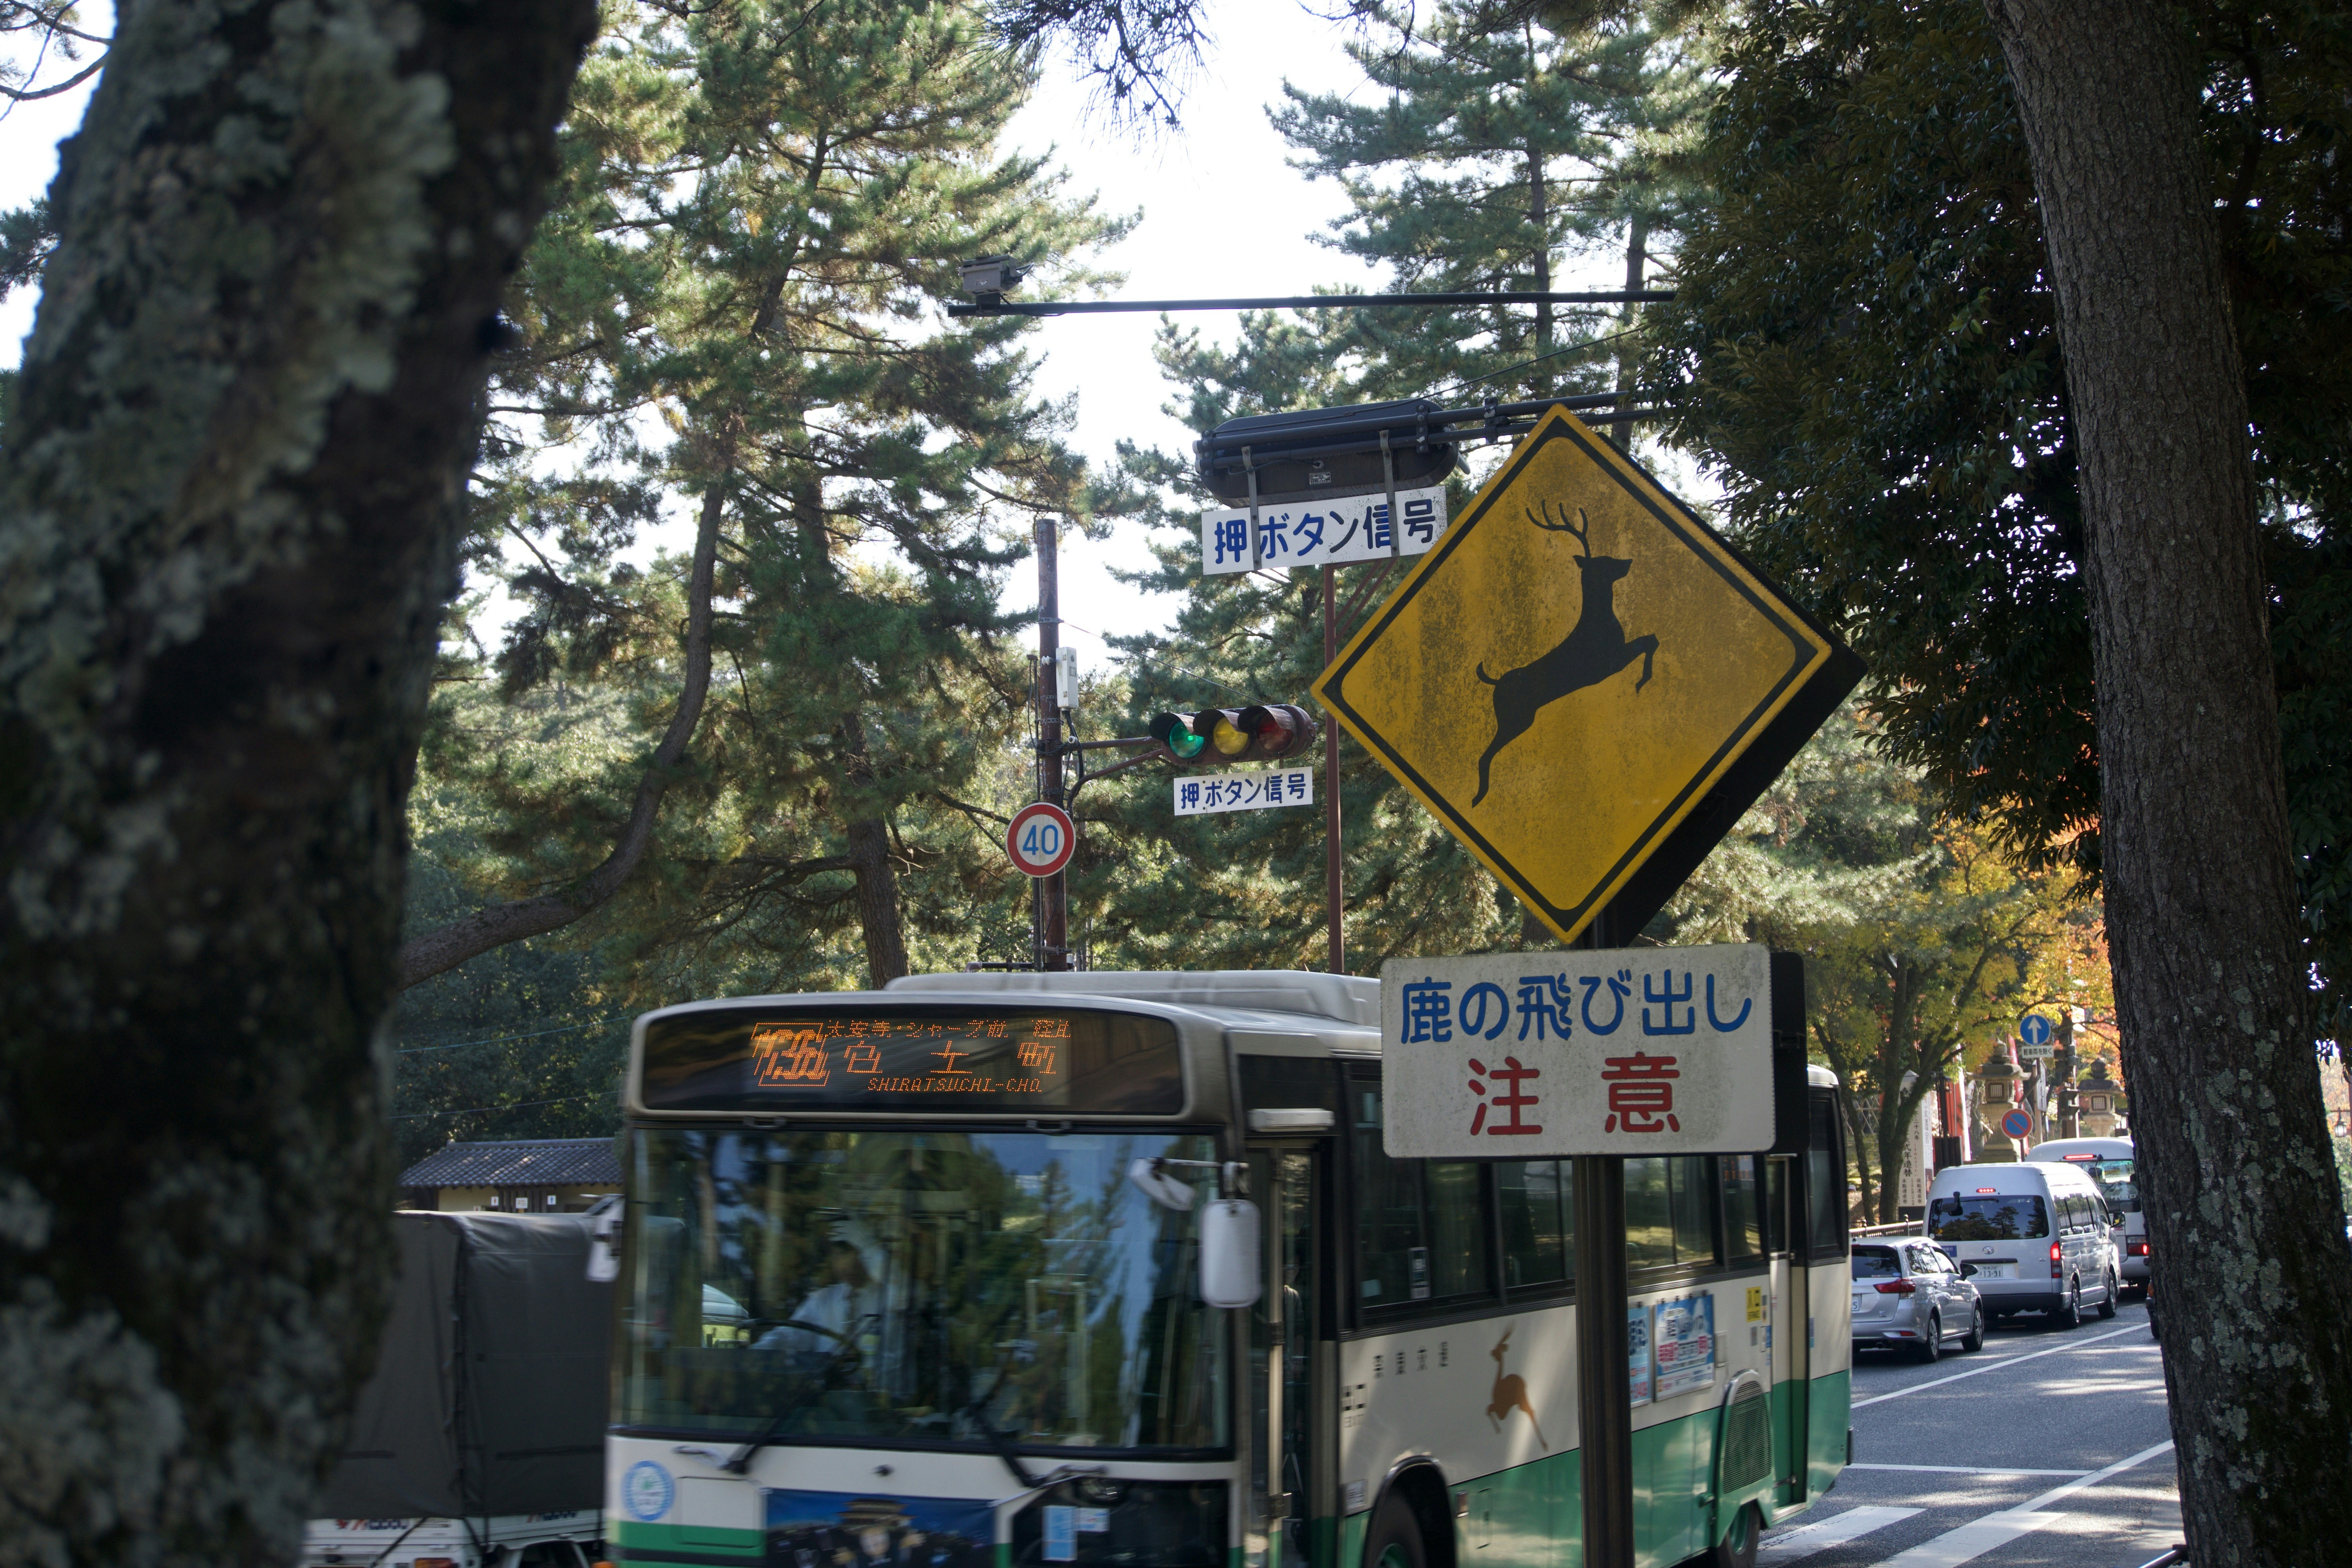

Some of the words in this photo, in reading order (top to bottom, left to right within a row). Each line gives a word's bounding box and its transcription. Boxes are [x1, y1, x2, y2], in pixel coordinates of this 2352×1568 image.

[1215, 499, 1436, 564] 押ボタン信号
[1181, 773, 1306, 809] 押ボタン信号
[1022, 824, 1058, 855] 40
[1401, 969, 1752, 1044] 鹿の飛び出し
